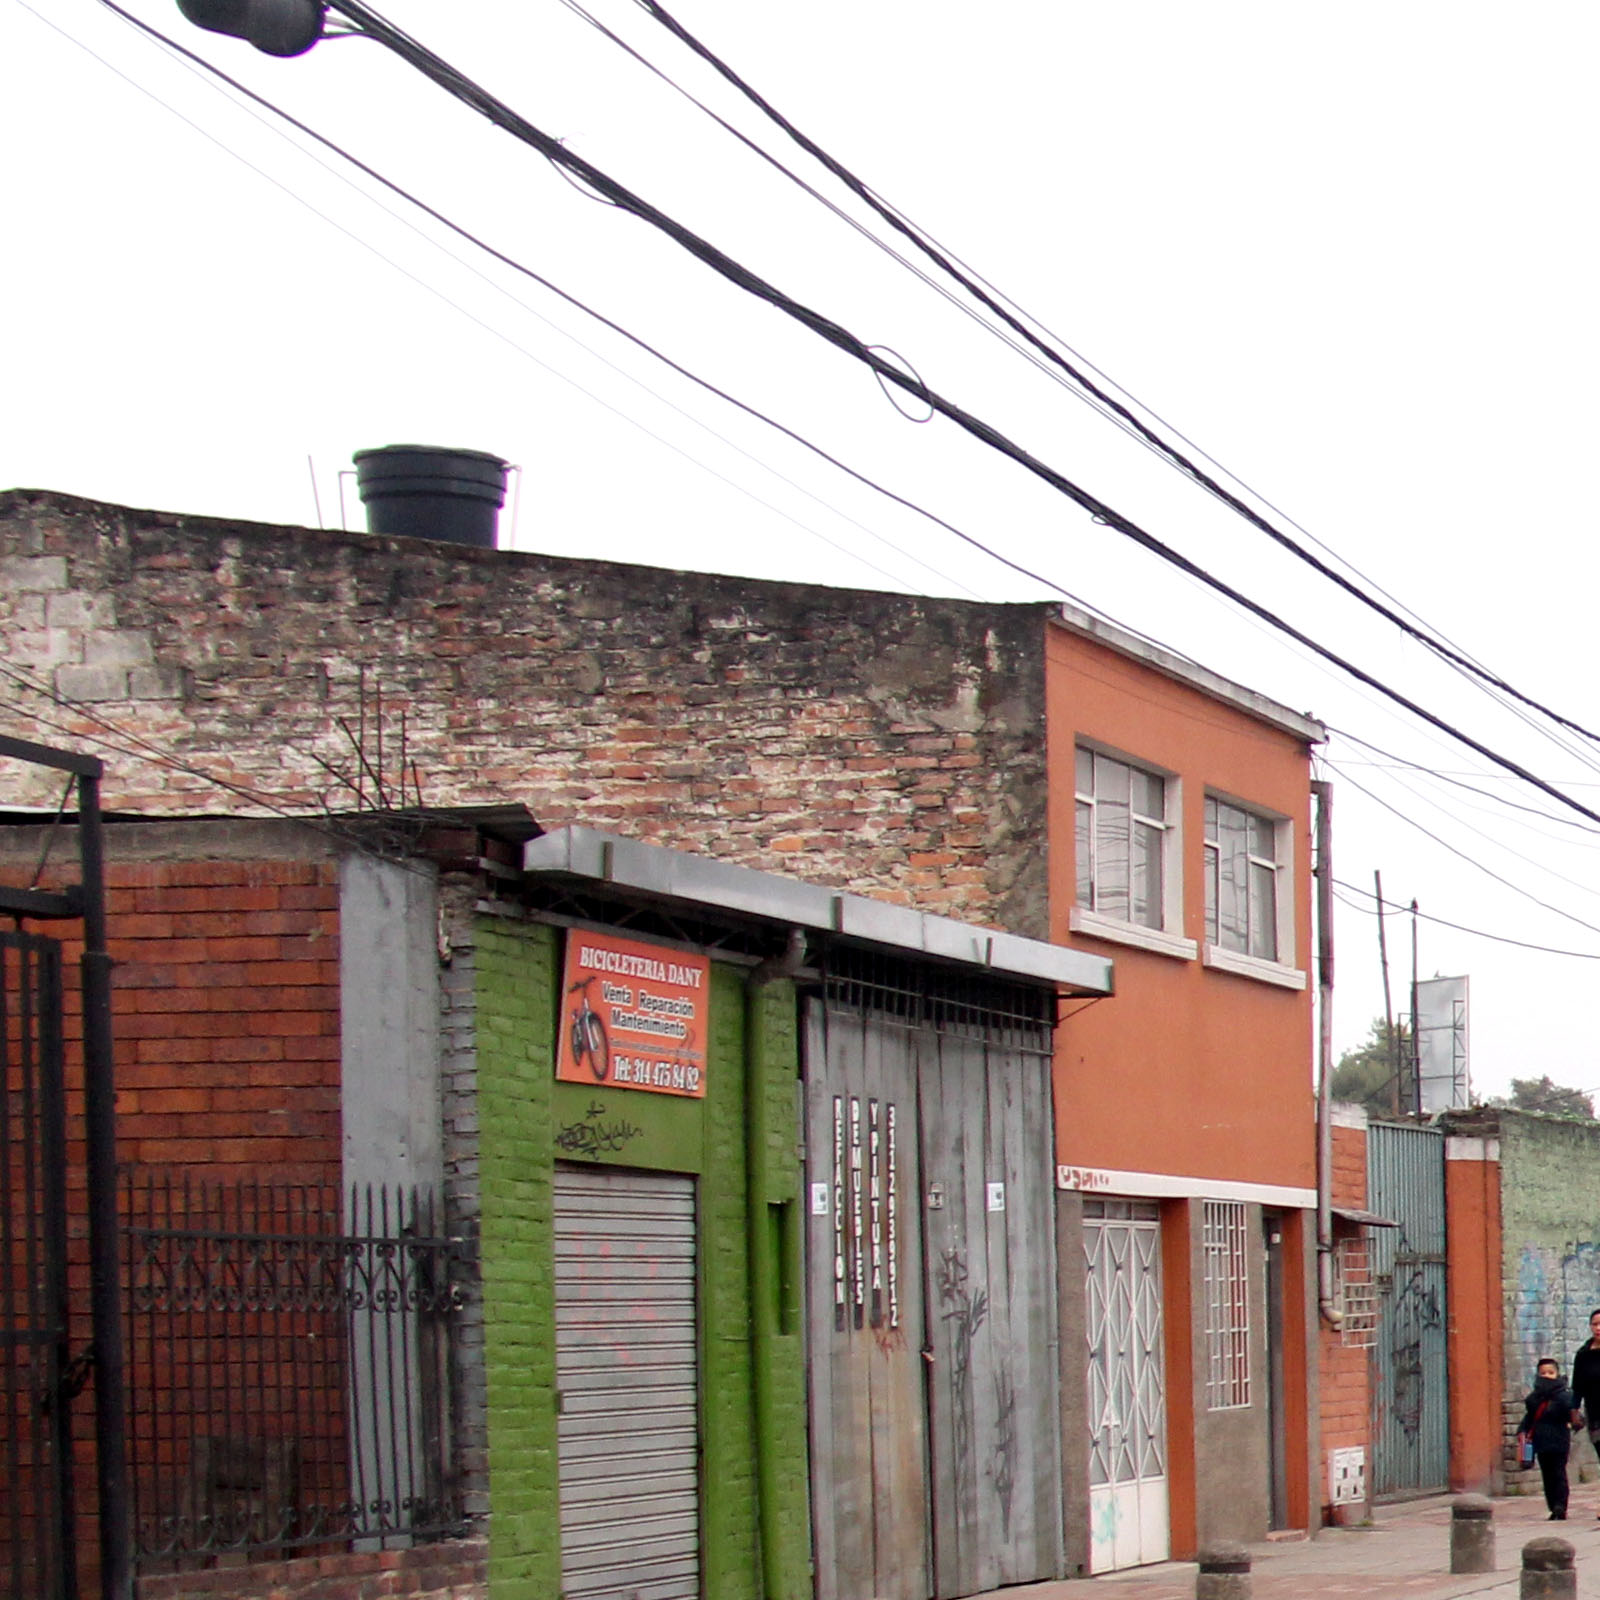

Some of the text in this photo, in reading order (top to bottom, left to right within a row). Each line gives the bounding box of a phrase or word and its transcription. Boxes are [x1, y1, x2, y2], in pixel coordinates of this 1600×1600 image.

[580, 946, 703, 988] BICICLETERIA DANY
[602, 980, 633, 1006] Venta
[610, 1007, 688, 1039] Mantenimiento
[633, 1058, 651, 1084] 314
[652, 1061, 670, 1087] 475
